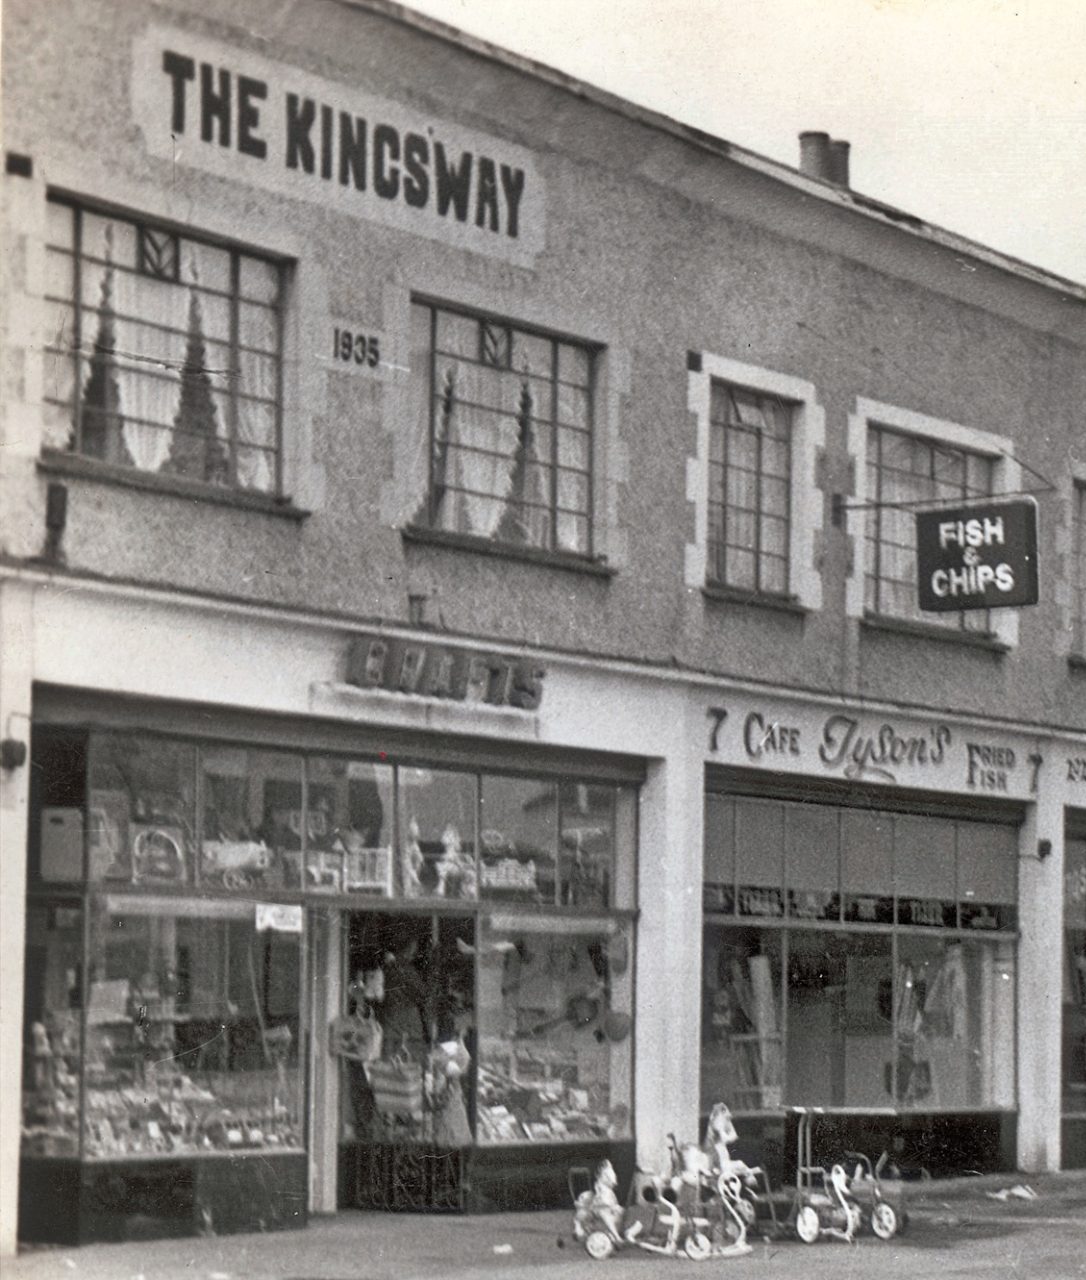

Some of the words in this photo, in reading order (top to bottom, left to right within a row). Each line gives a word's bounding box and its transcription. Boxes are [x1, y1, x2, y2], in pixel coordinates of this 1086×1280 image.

[162, 50, 267, 159] THE
[286, 92, 525, 238] KINGSWAY
[333, 328, 380, 368] 1935
[939, 516, 1005, 549] FISH
[963, 546, 980, 567] &
[931, 563, 1015, 597] CHIPS
